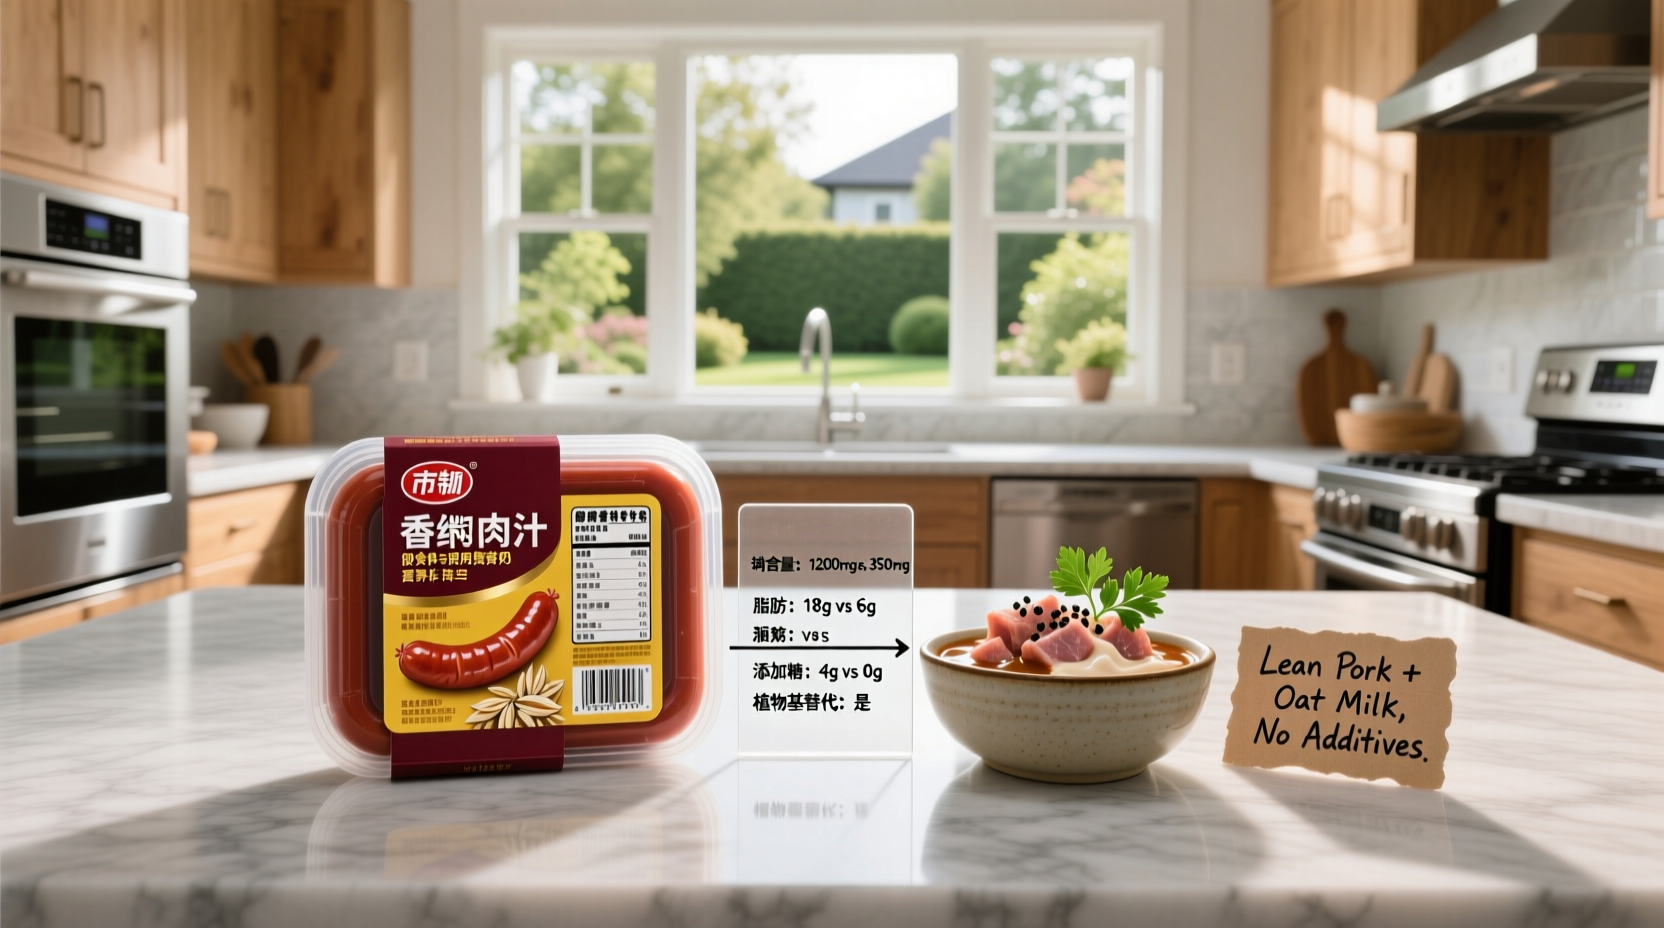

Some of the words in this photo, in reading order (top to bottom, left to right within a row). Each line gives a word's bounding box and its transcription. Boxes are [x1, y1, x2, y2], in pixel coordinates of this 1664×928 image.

[836, 601, 853, 613] vs
[857, 597, 876, 617] 6g
[842, 667, 859, 679] vs
[863, 663, 883, 683] 0g
[1259, 644, 1322, 678] Lean
[1336, 650, 1392, 683] Pork
[1402, 664, 1422, 683] +
[1274, 684, 1326, 711] Oat
[1335, 689, 1406, 724] Milk,
[1253, 717, 1290, 746] No
[1301, 720, 1429, 763] Additives.
